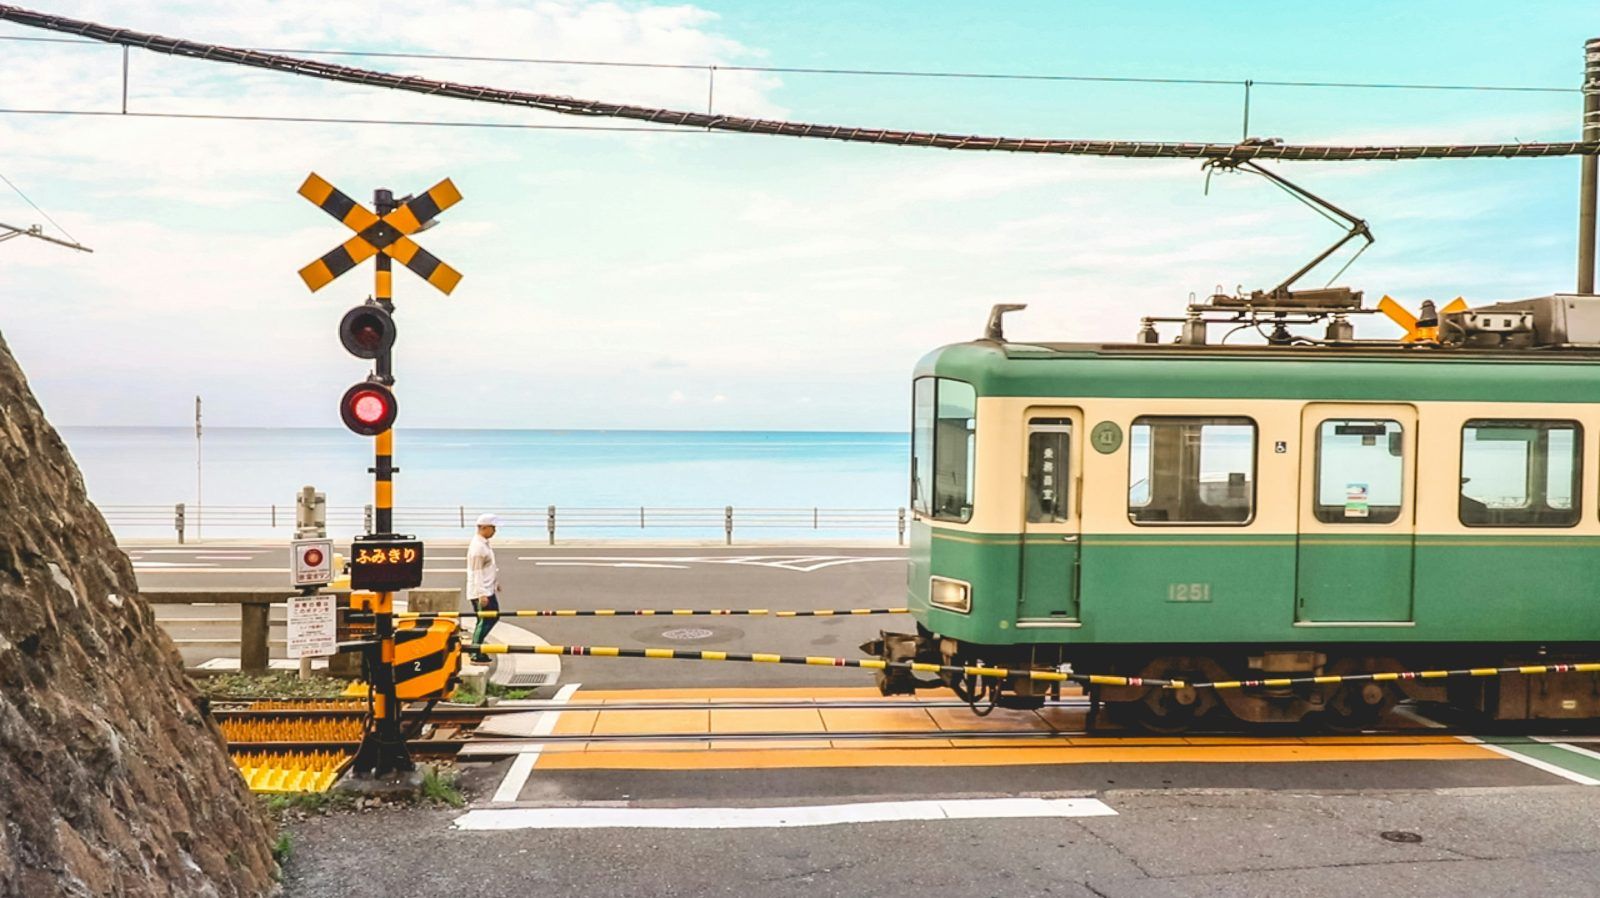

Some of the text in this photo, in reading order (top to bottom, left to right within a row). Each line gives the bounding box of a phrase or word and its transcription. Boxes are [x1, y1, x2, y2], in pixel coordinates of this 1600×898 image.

[355, 547, 416, 564] ふみきり
[1168, 582, 1210, 601] 1251
[414, 661, 422, 672] 2
